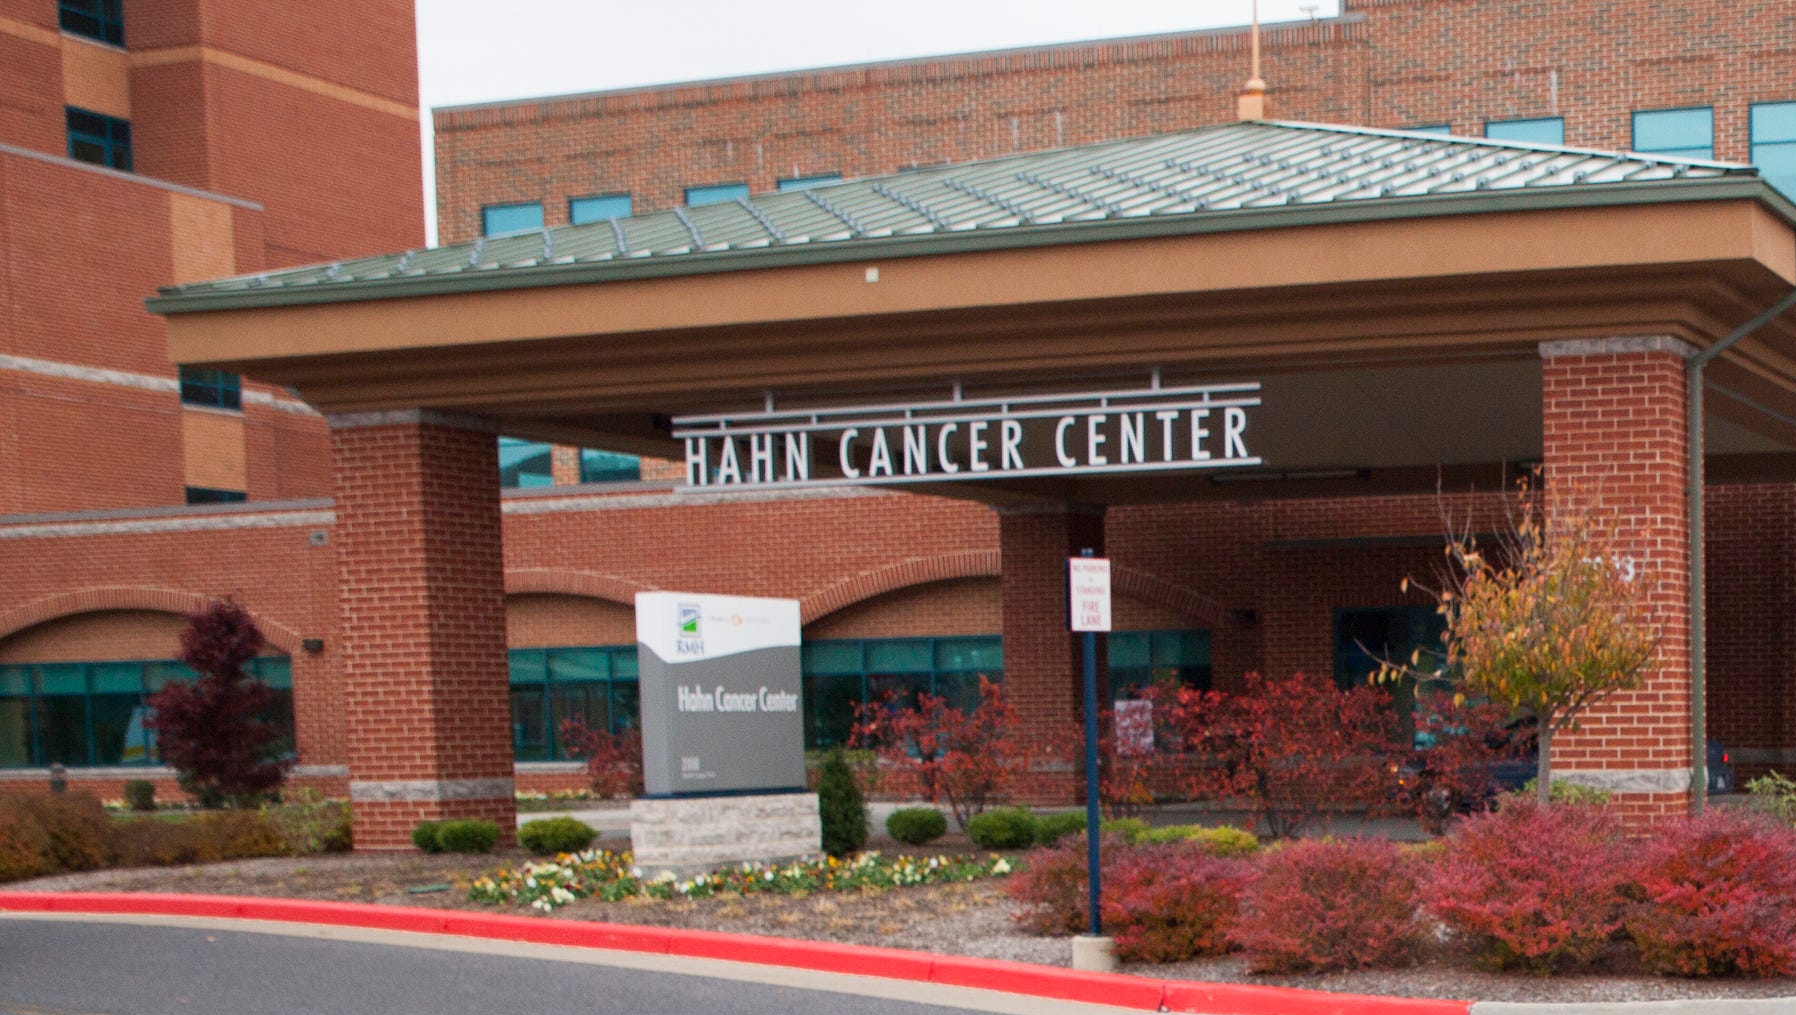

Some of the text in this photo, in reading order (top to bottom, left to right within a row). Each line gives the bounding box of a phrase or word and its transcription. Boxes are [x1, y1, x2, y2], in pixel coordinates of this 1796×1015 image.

[685, 407, 1250, 486] HAHN CANCER CENTER
[678, 684, 799, 712] Hahn Cancer Center
